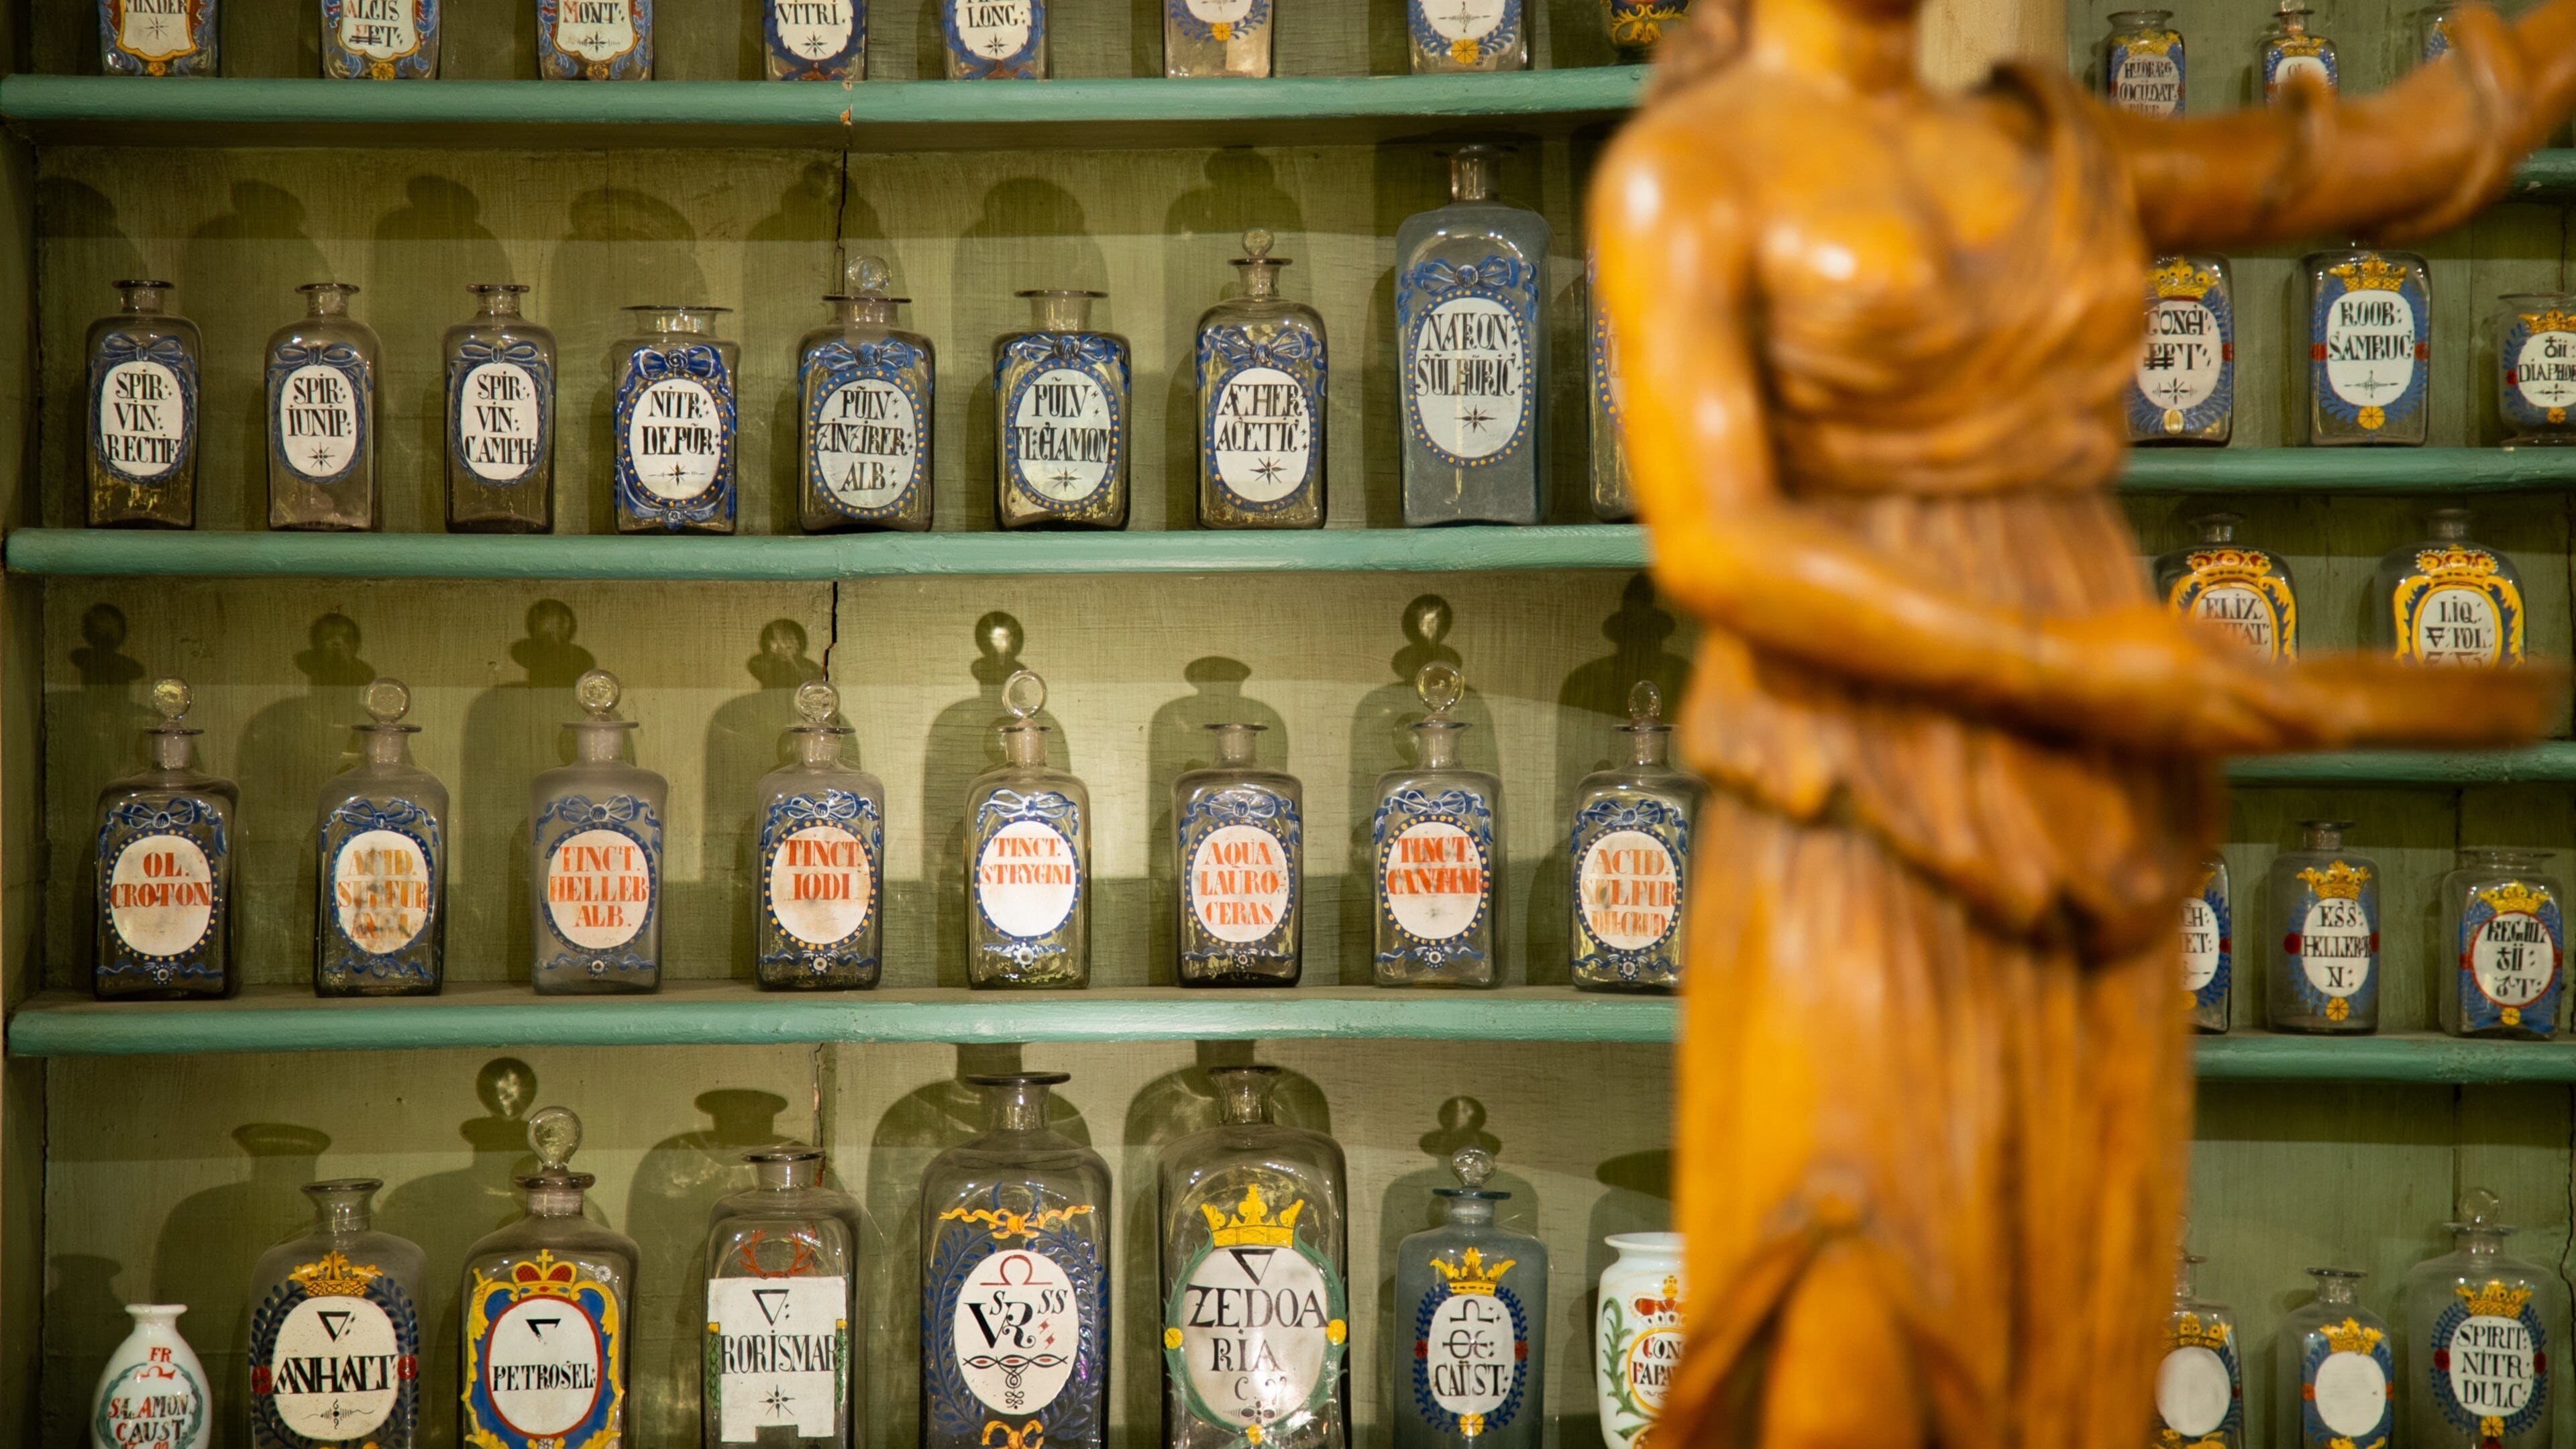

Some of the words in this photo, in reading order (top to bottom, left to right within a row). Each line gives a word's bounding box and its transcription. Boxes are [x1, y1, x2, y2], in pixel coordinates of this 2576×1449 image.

[2339, 301, 2402, 327] ROOB:
[115, 369, 173, 400] SPIR:
[293, 373, 347, 405] SPIR:
[477, 371, 530, 401] SPIR:
[113, 400, 164, 432] VIN:
[474, 402, 521, 433] VIN:
[143, 852, 189, 878] OL.
[1204, 842, 1273, 868] AQUA
[109, 881, 213, 910] CROTON
[792, 873, 851, 901] IODI
[1582, 879, 1676, 908] SULFUR
[574, 905, 631, 927] ALB.
[1185, 1283, 1329, 1328] ZEDOA
[149, 1347, 172, 1363] FR
[720, 1330, 838, 1375] RORISMAR
[1210, 1329, 1286, 1372] RIA
